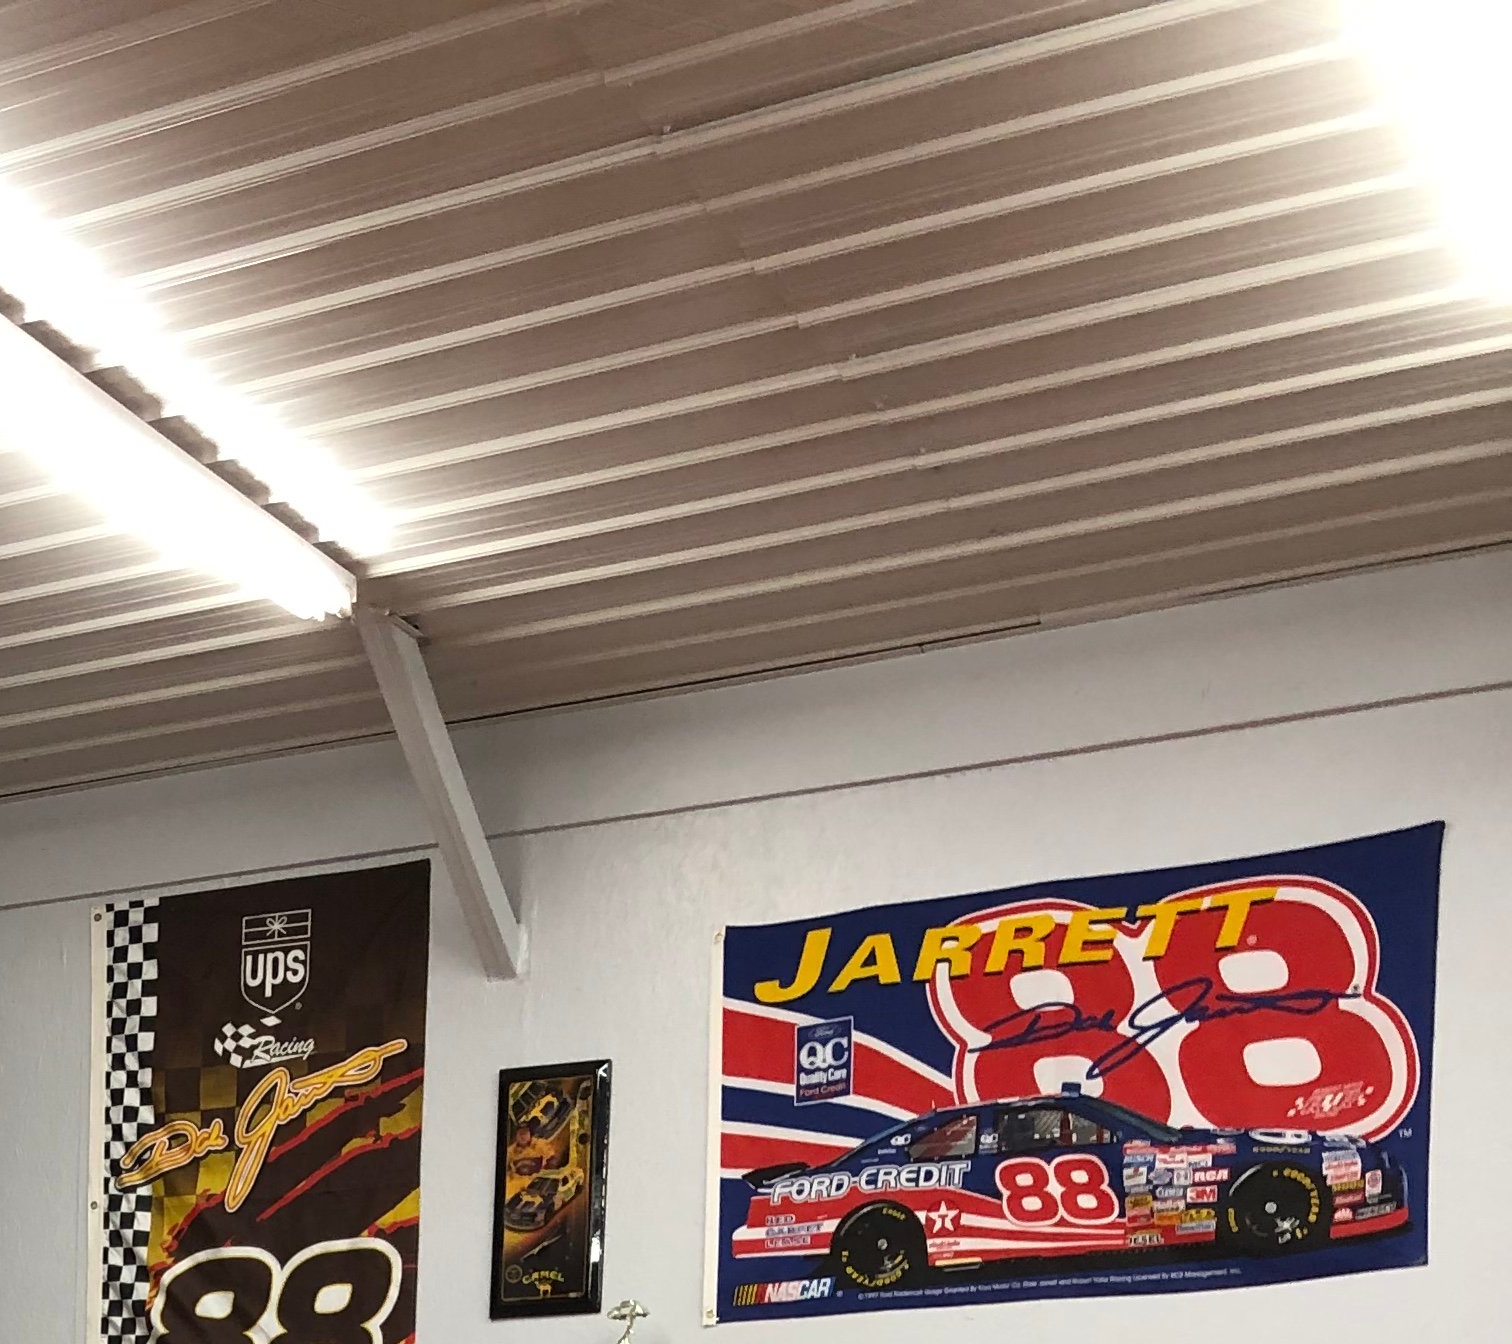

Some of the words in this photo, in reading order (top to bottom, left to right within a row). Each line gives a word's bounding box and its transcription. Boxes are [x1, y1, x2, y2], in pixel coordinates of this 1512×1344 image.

[753, 886, 1279, 1004] JARRETT
[245, 946, 306, 999] ups
[925, 873, 1420, 1145] 88
[252, 1034, 316, 1063] Racing
[799, 1036, 849, 1070] QC
[799, 1069, 828, 1085] Quality
[828, 1067, 847, 1082] Care
[993, 1153, 1120, 1225] 88
[1194, 1169, 1229, 1182] RCA
[522, 1270, 565, 1285] CAMEL
[763, 1277, 835, 1304] NASCAR
